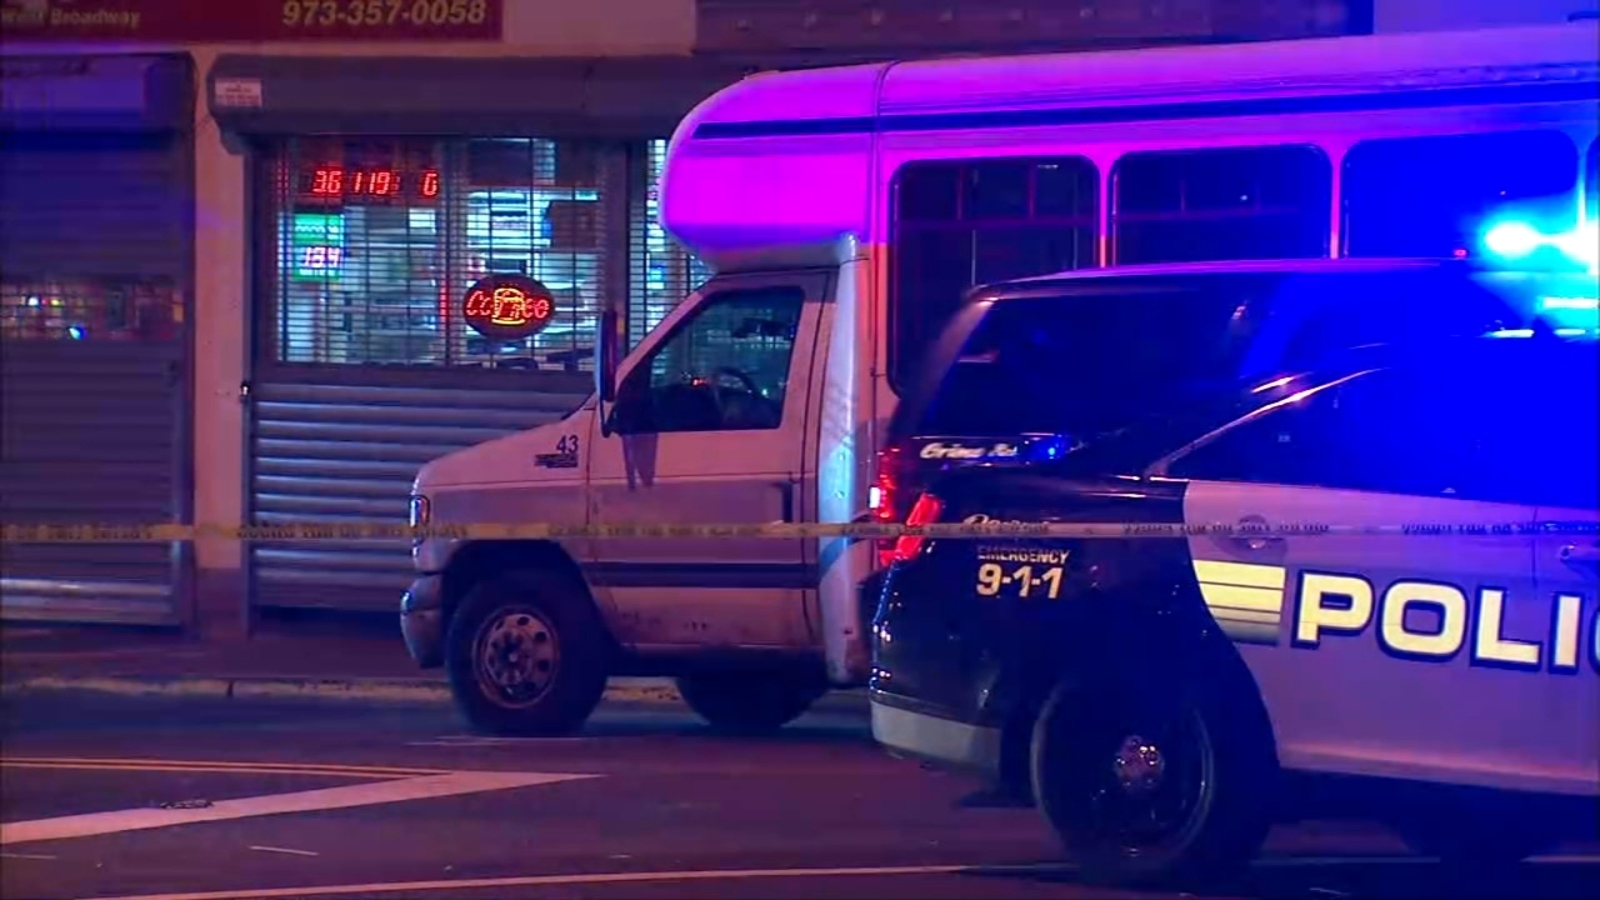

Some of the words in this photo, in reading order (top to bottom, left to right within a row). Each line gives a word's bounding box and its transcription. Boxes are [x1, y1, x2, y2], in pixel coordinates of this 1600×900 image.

[50, 8, 140, 29] Broadway
[283, 0, 486, 25] 973-357-0058
[556, 435, 579, 454] 43
[977, 546, 1071, 564] EMERGENCY
[976, 563, 1063, 599] 9-1-1
[1292, 570, 1600, 675] POLI
